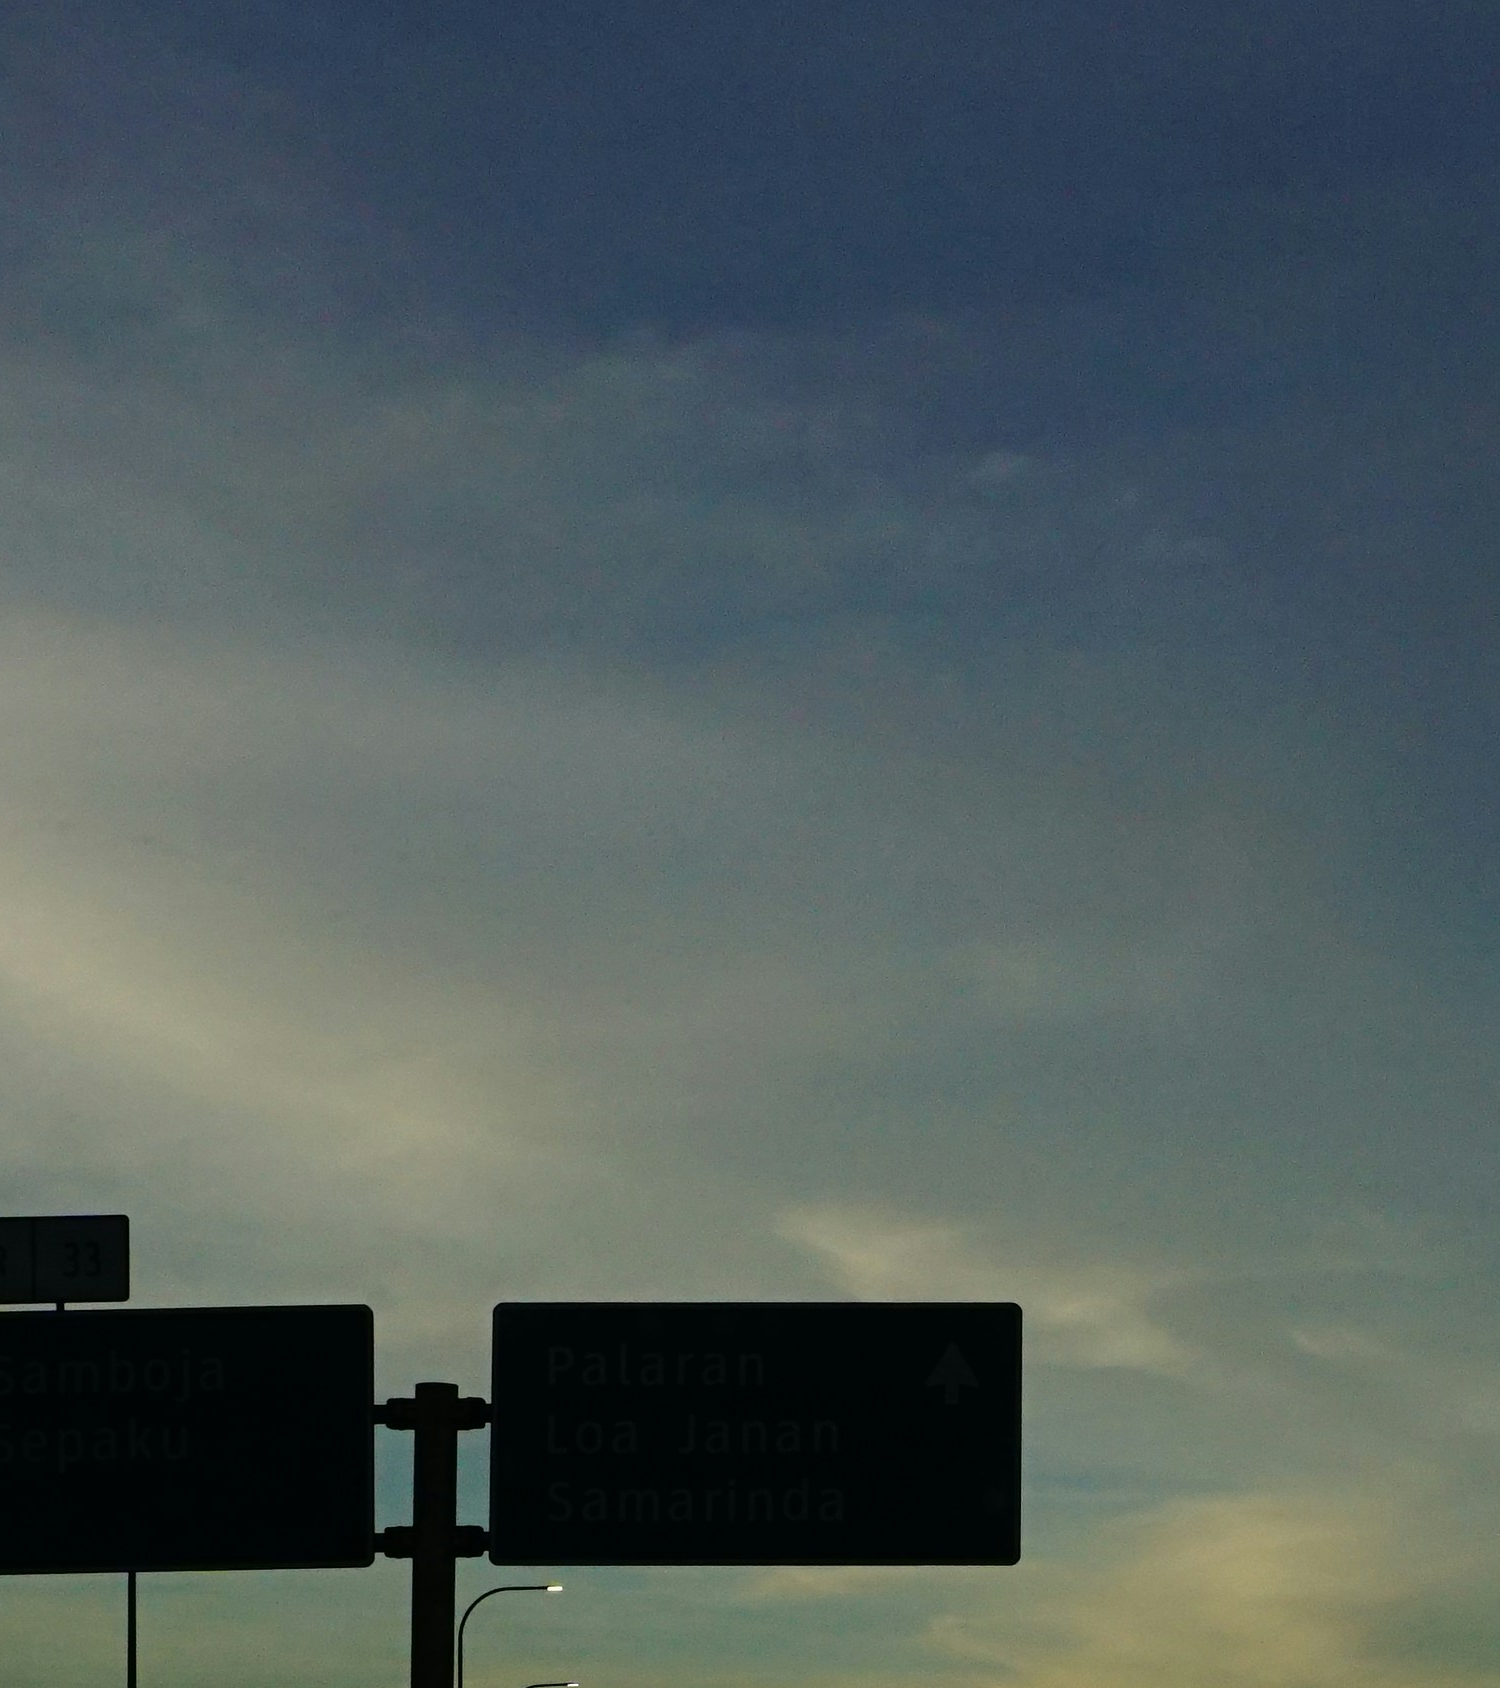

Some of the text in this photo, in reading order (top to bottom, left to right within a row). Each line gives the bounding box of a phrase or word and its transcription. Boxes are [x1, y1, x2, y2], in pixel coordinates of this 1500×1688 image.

[62, 1241, 103, 1277] 33
[546, 1342, 766, 1388] Palaran
[547, 1413, 841, 1455] Loa Janan
[547, 1479, 846, 1524] Samarinda
